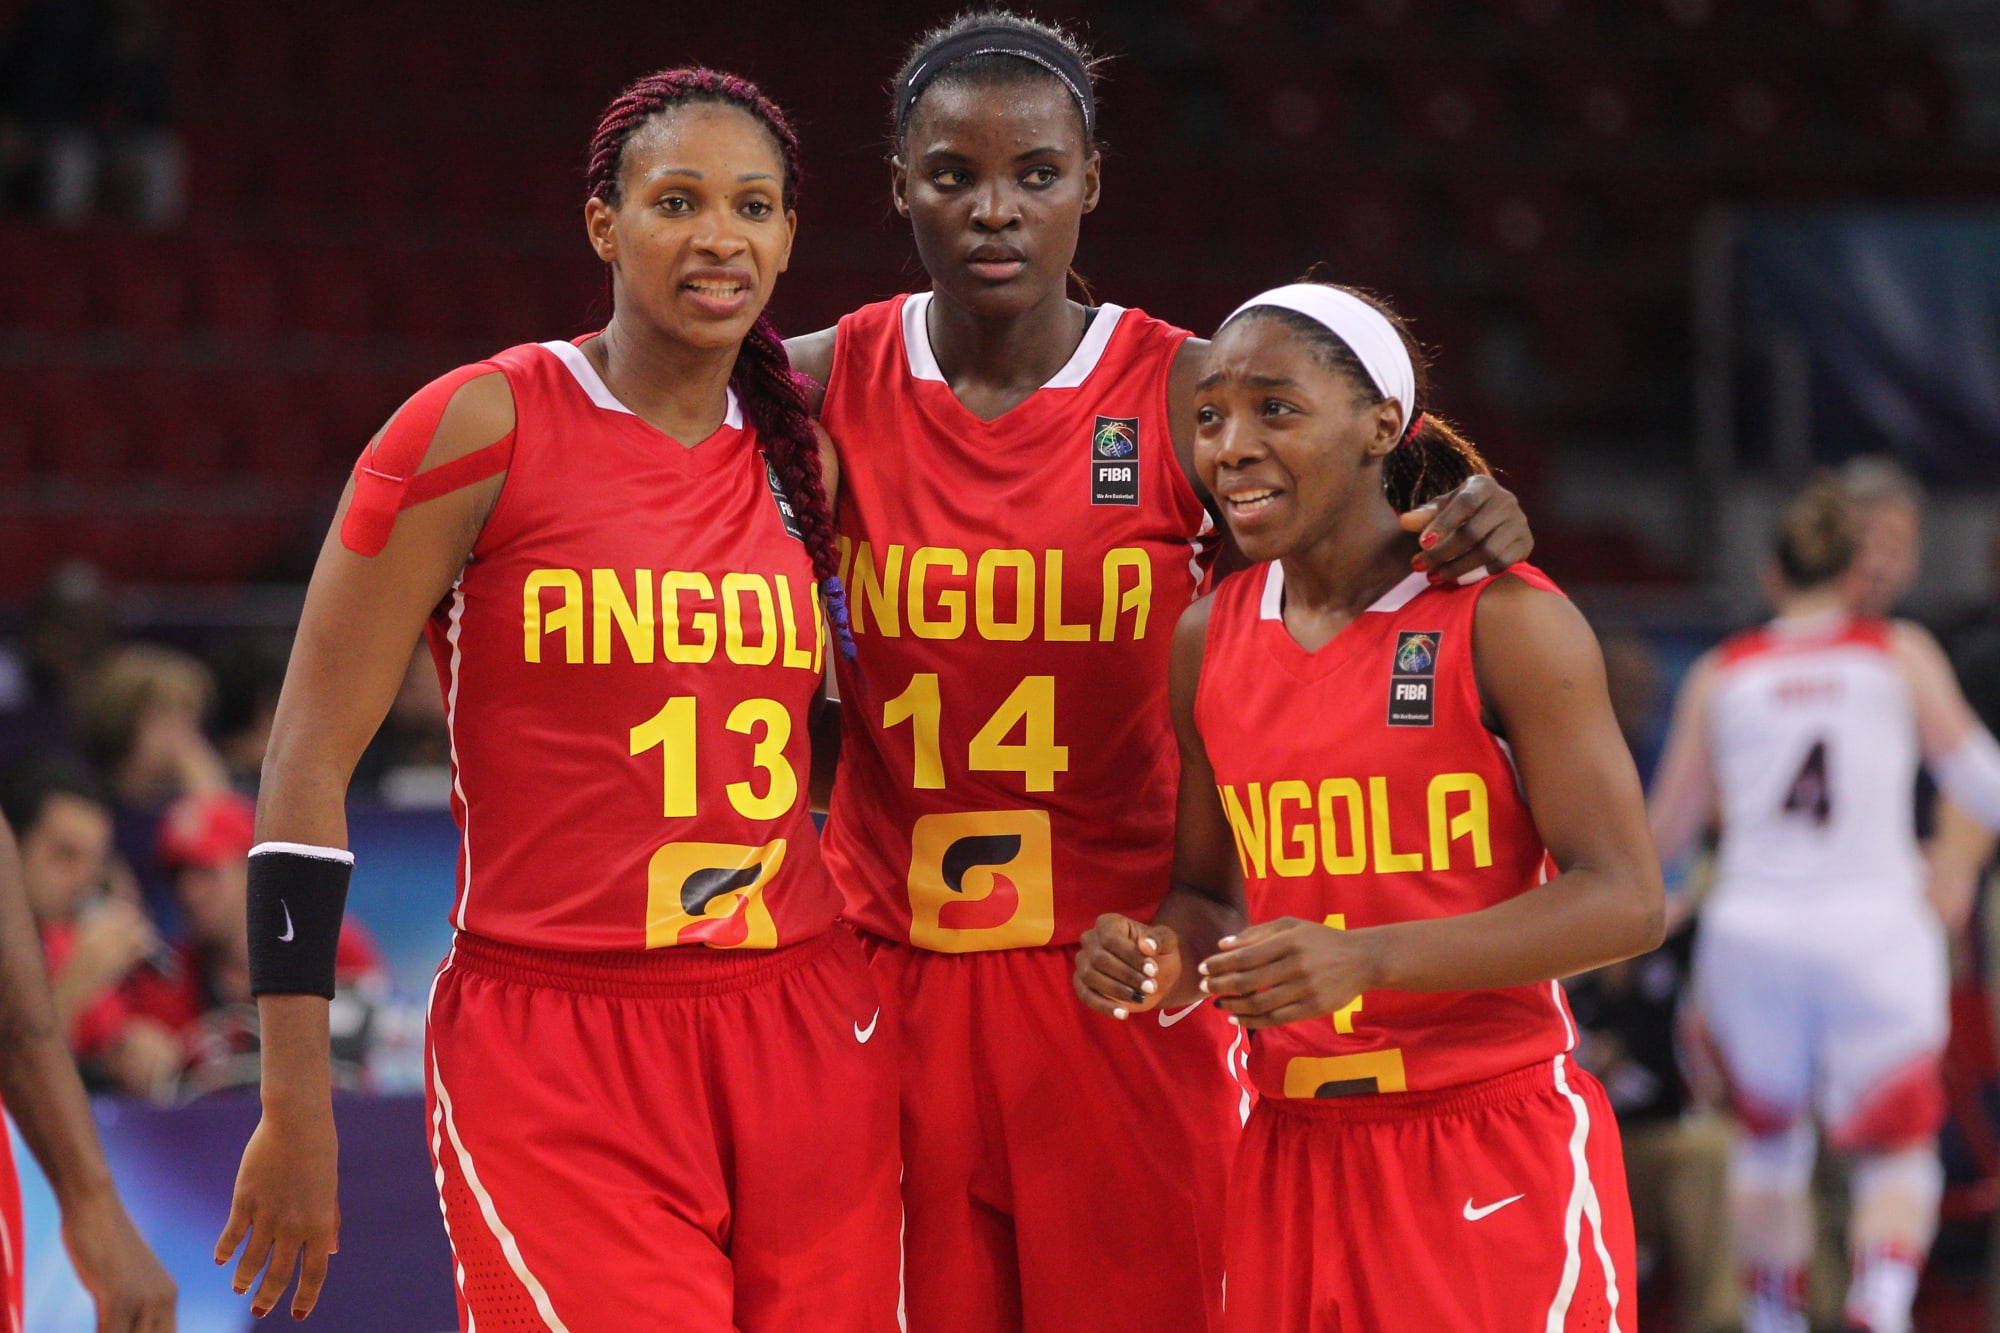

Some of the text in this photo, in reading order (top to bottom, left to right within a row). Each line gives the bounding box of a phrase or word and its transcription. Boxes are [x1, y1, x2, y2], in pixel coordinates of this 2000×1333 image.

[1098, 466, 1132, 482] FIBA
[883, 673, 1068, 792] 14
[1395, 684, 1428, 701] FIBA
[630, 696, 798, 820] 13
[1781, 735, 1833, 829] 4
[1216, 772, 1493, 879] NGOLA
